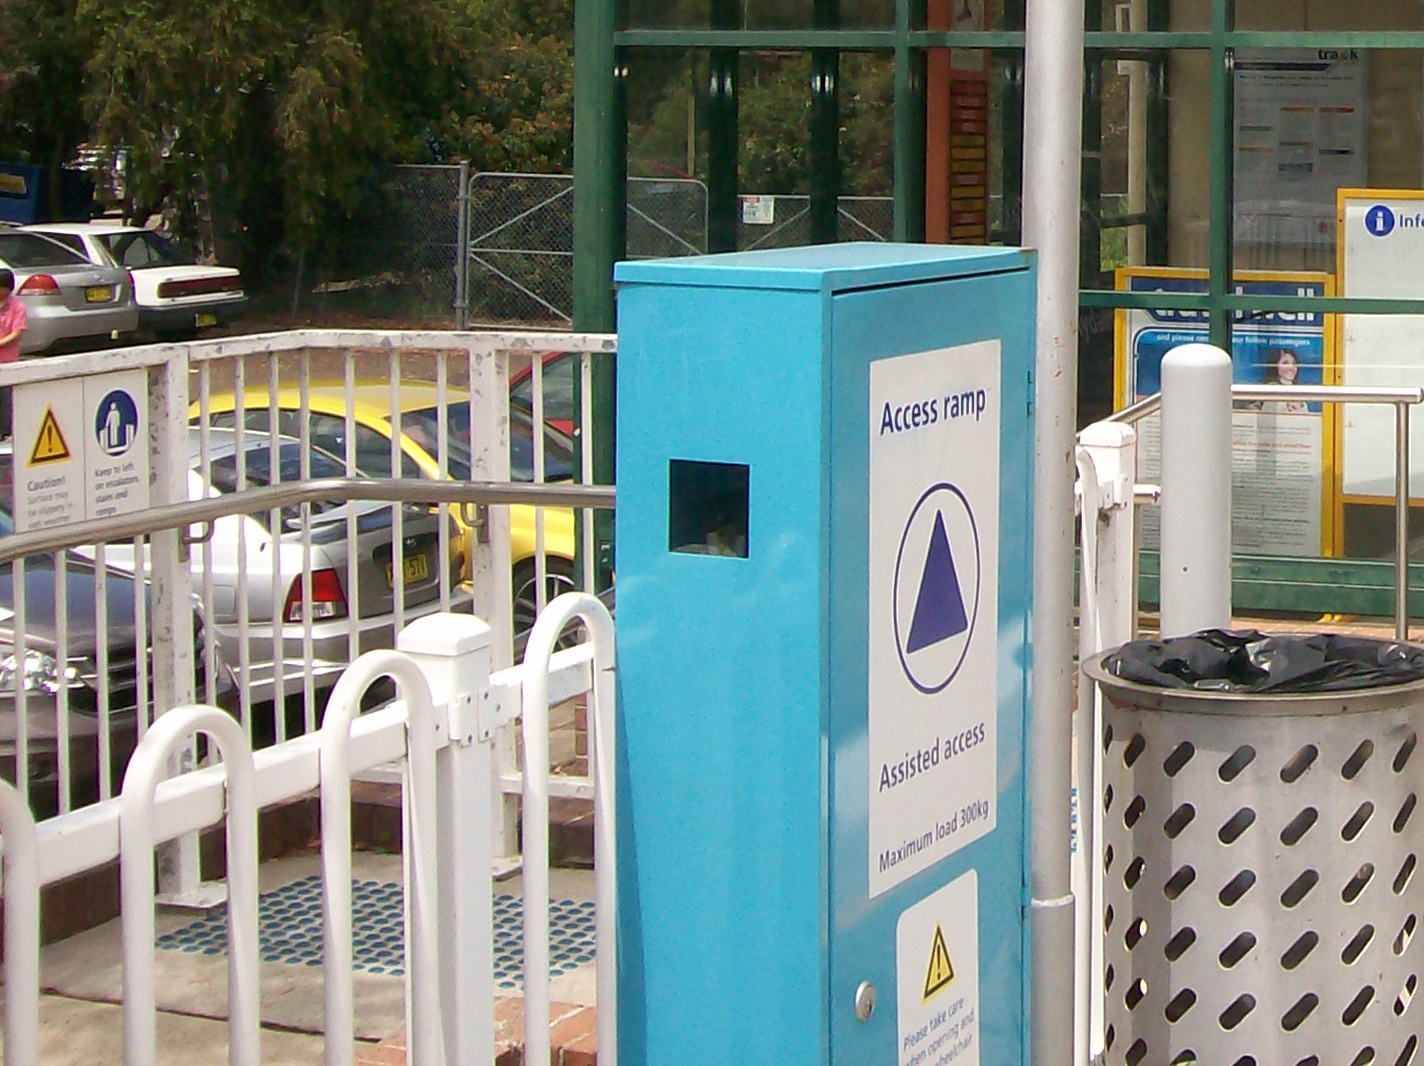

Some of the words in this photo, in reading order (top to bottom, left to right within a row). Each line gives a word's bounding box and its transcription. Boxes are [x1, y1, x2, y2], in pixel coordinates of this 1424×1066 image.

[880, 398, 938, 436] Access
[943, 388, 986, 422] ramp
[879, 737, 940, 793] Assisted
[944, 722, 985, 760] access
[879, 832, 933, 873] Maximum
[935, 812, 958, 842] load
[960, 799, 989, 828] 300kg
[903, 1025, 928, 1052] Please
[929, 1011, 947, 1031] take
[948, 998, 964, 1017] care
[928, 1023, 959, 1056] opening
[960, 1006, 974, 1030] and
